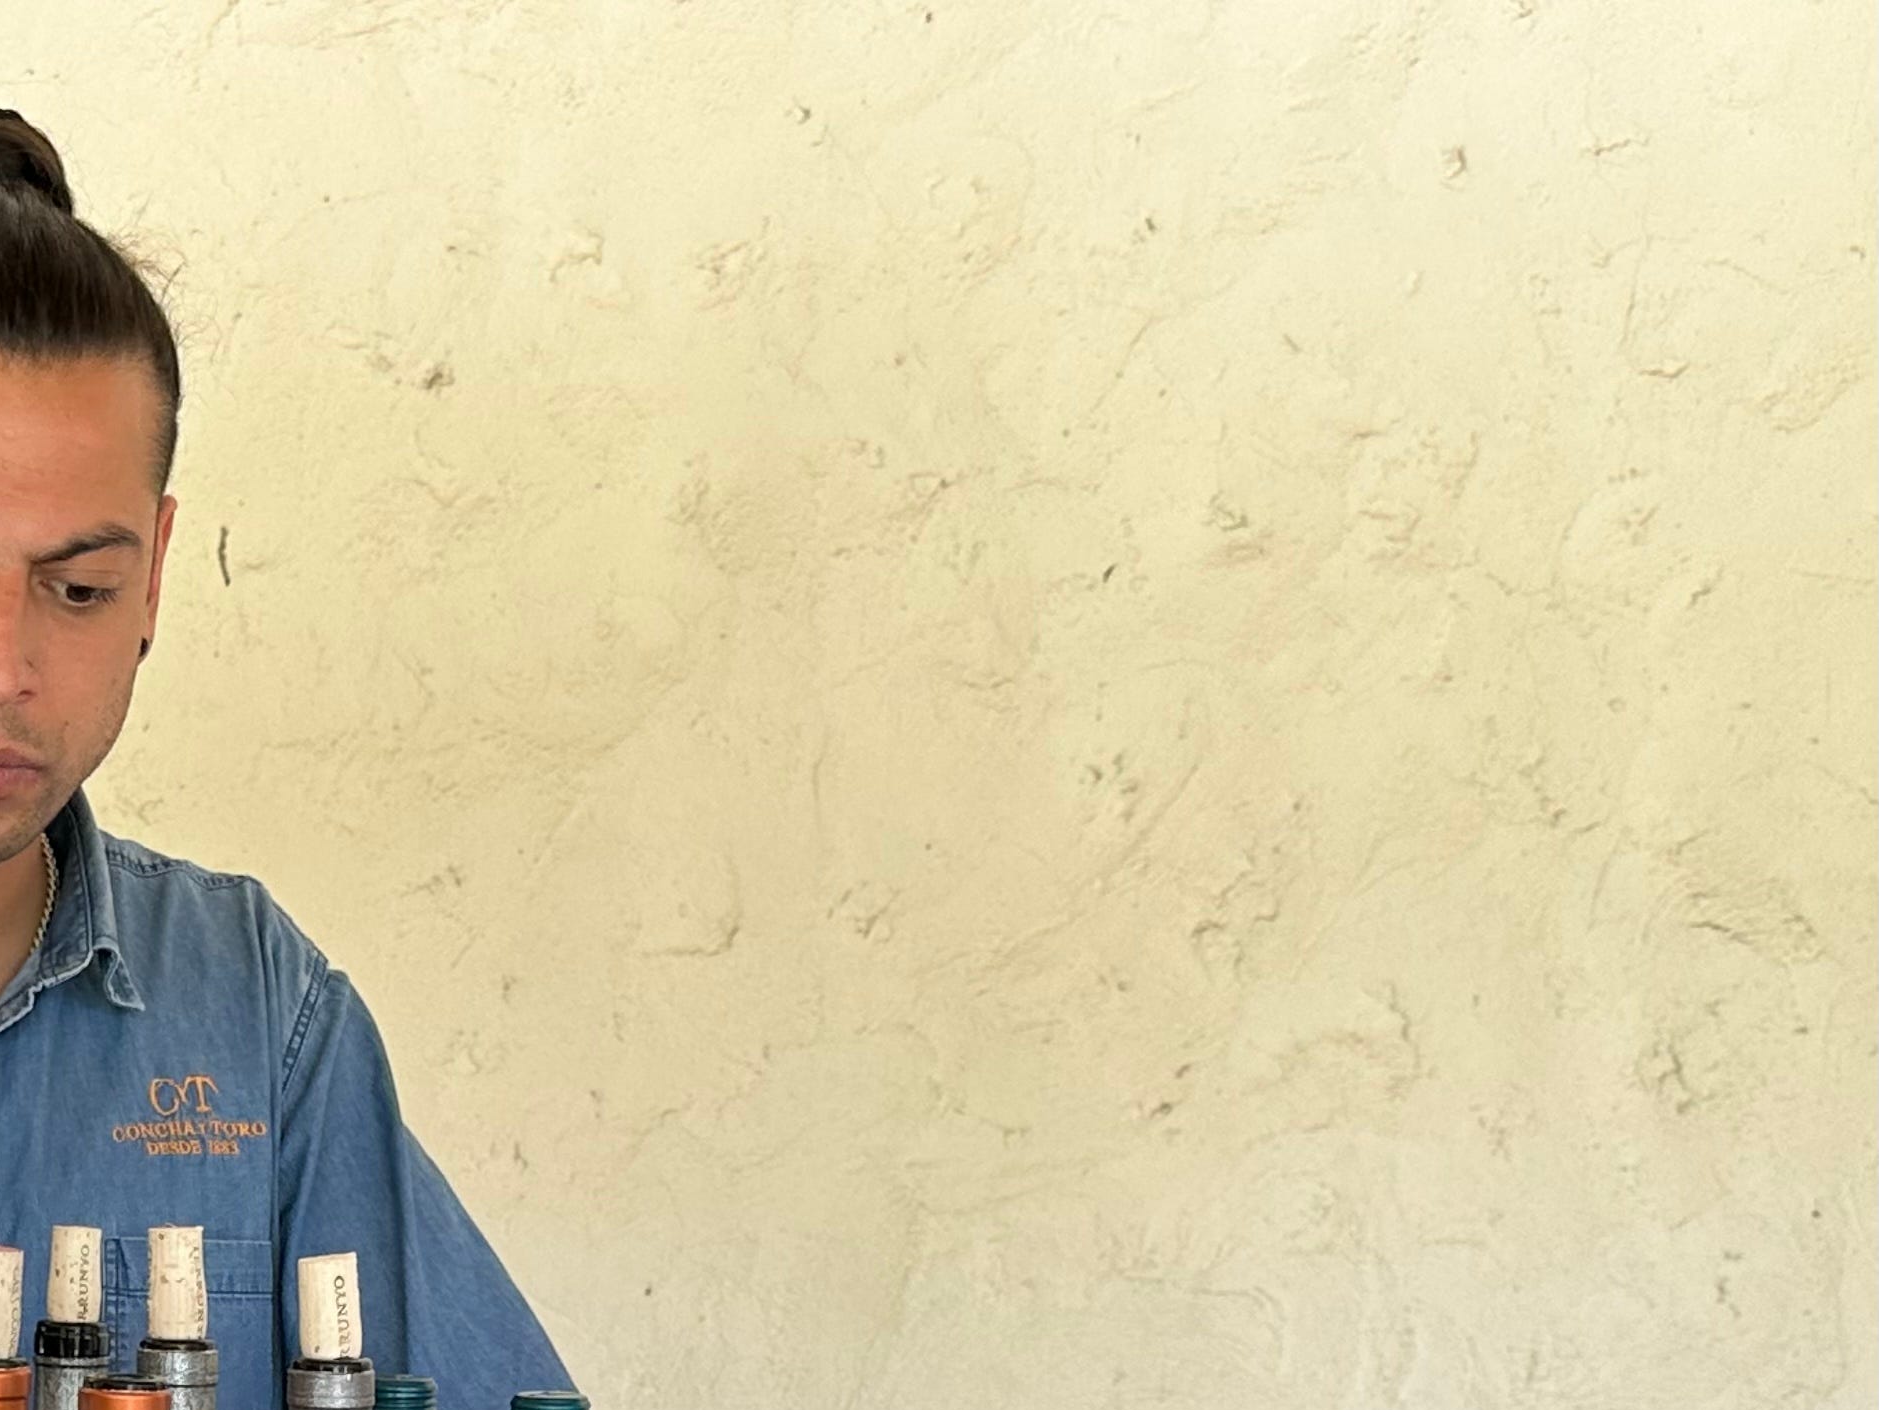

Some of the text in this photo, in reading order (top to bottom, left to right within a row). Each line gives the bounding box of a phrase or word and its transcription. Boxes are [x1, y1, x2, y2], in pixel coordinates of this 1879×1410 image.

[112, 1121, 194, 1142] CONCHA
[211, 1119, 267, 1136] TORO
[146, 1141, 201, 1155] DESDE
